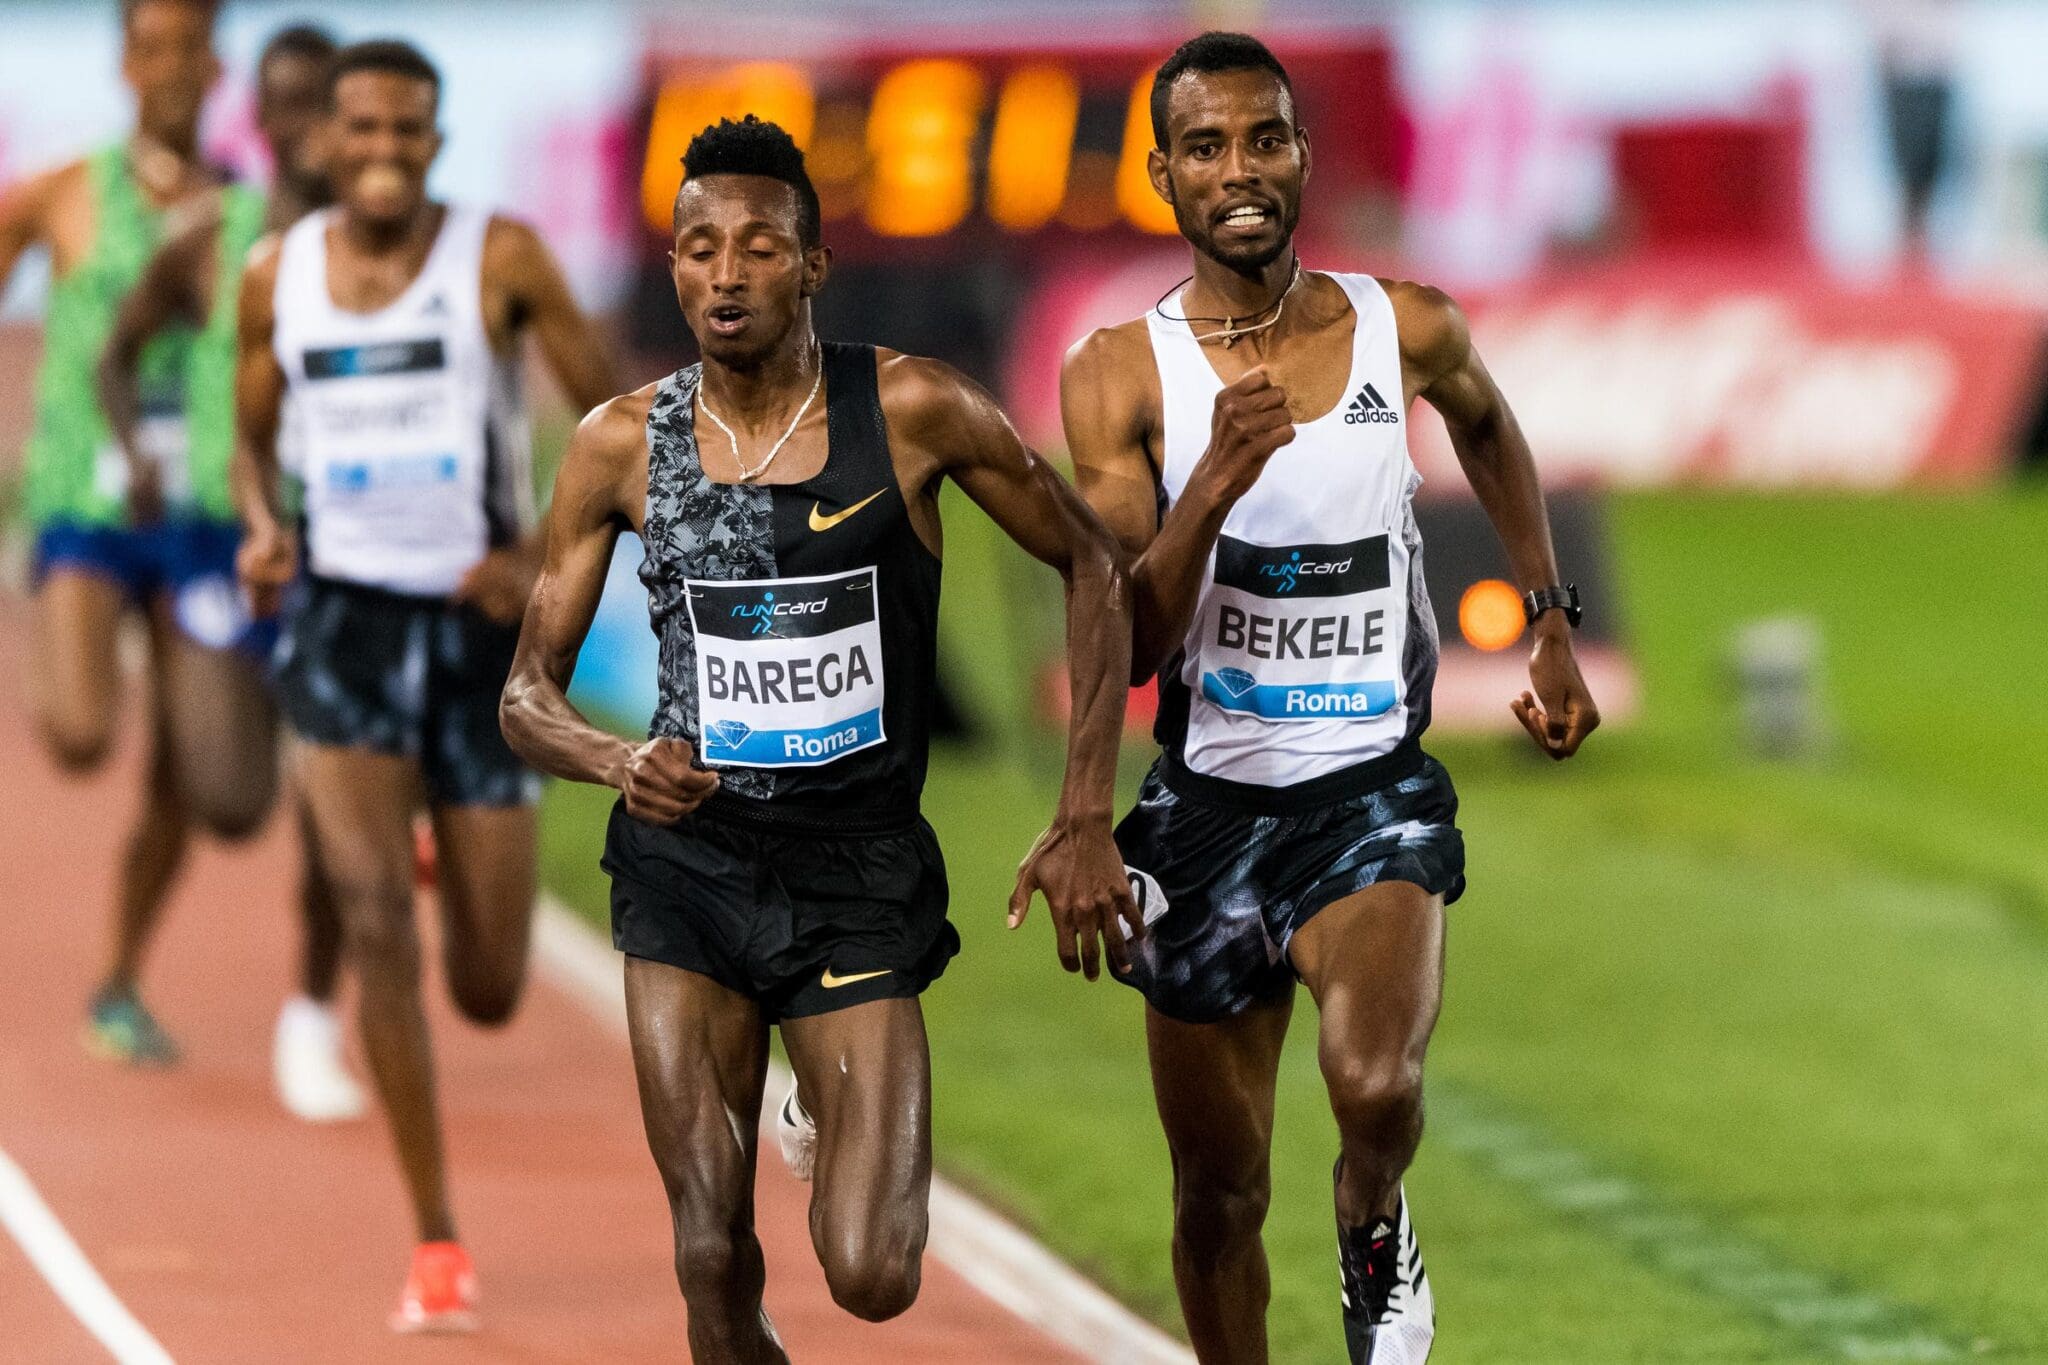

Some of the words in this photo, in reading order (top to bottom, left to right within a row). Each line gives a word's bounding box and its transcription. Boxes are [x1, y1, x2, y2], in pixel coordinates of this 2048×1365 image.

[1344, 408, 1399, 424] adidas
[1217, 604, 1384, 660] BEKELE
[706, 644, 874, 705] BAREGA
[1286, 689, 1368, 713] Roma
[783, 726, 858, 758] Roma
